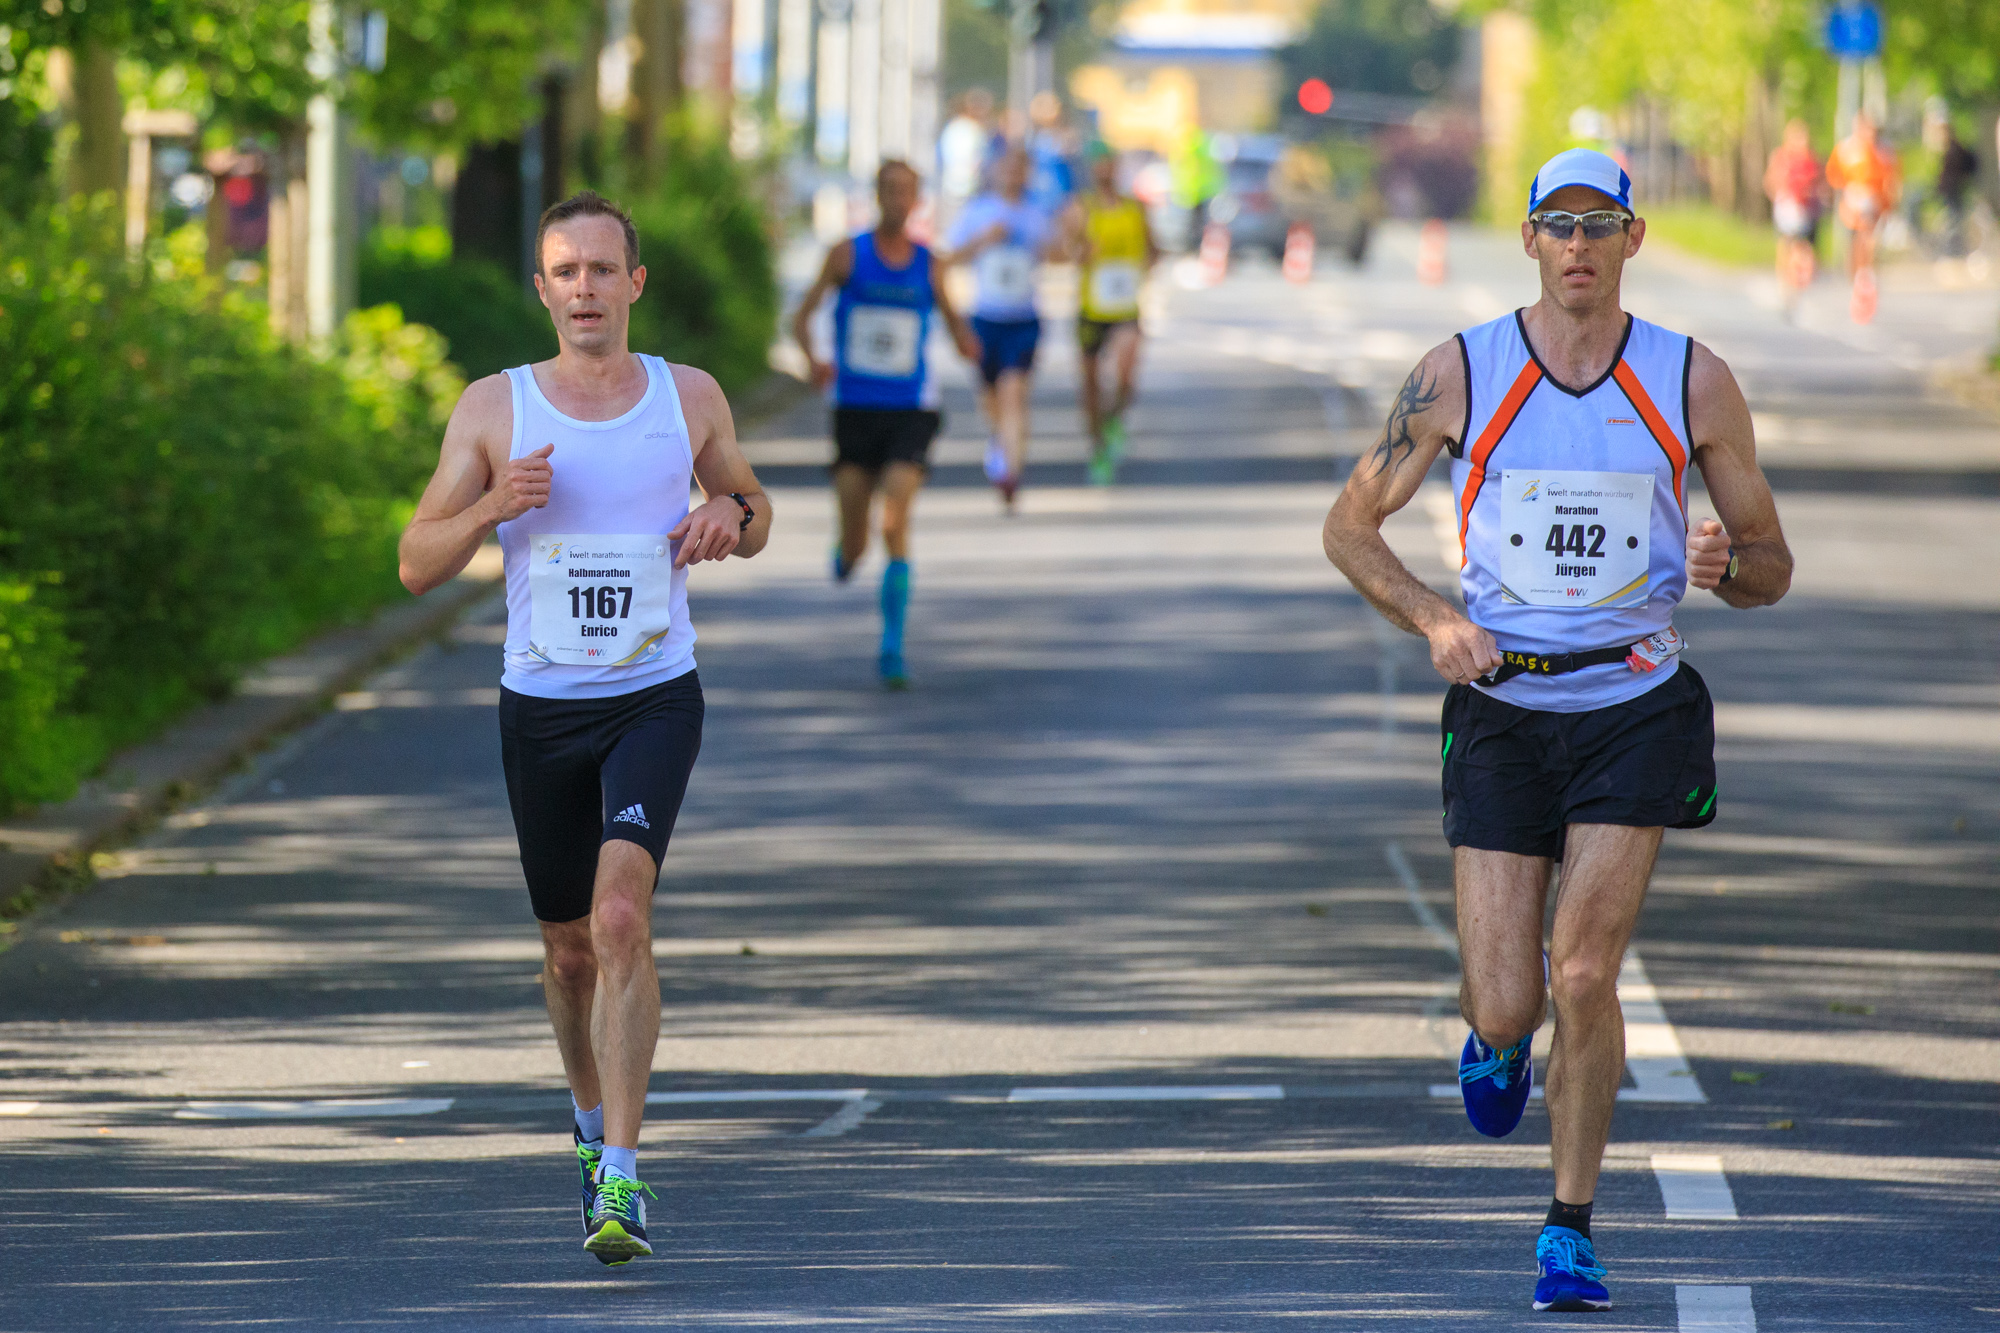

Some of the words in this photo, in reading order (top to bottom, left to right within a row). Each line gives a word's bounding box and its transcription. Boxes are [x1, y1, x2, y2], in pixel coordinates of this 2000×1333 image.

[1548, 488, 1568, 497] iwelt
[1570, 489, 1603, 497] marathon
[1555, 505, 1598, 515] Marathon
[1545, 524, 1606, 558] 442
[569, 551, 589, 559] iwelt
[592, 551, 624, 559] marathon
[568, 568, 630, 578] Halbmarathon
[1555, 563, 1596, 577] Jürgen
[1566, 587, 1588, 596] WVV
[568, 586, 633, 619] 1167
[581, 624, 618, 637] Enrico
[1652, 635, 1667, 652] Ge
[613, 813, 650, 830] adidas
